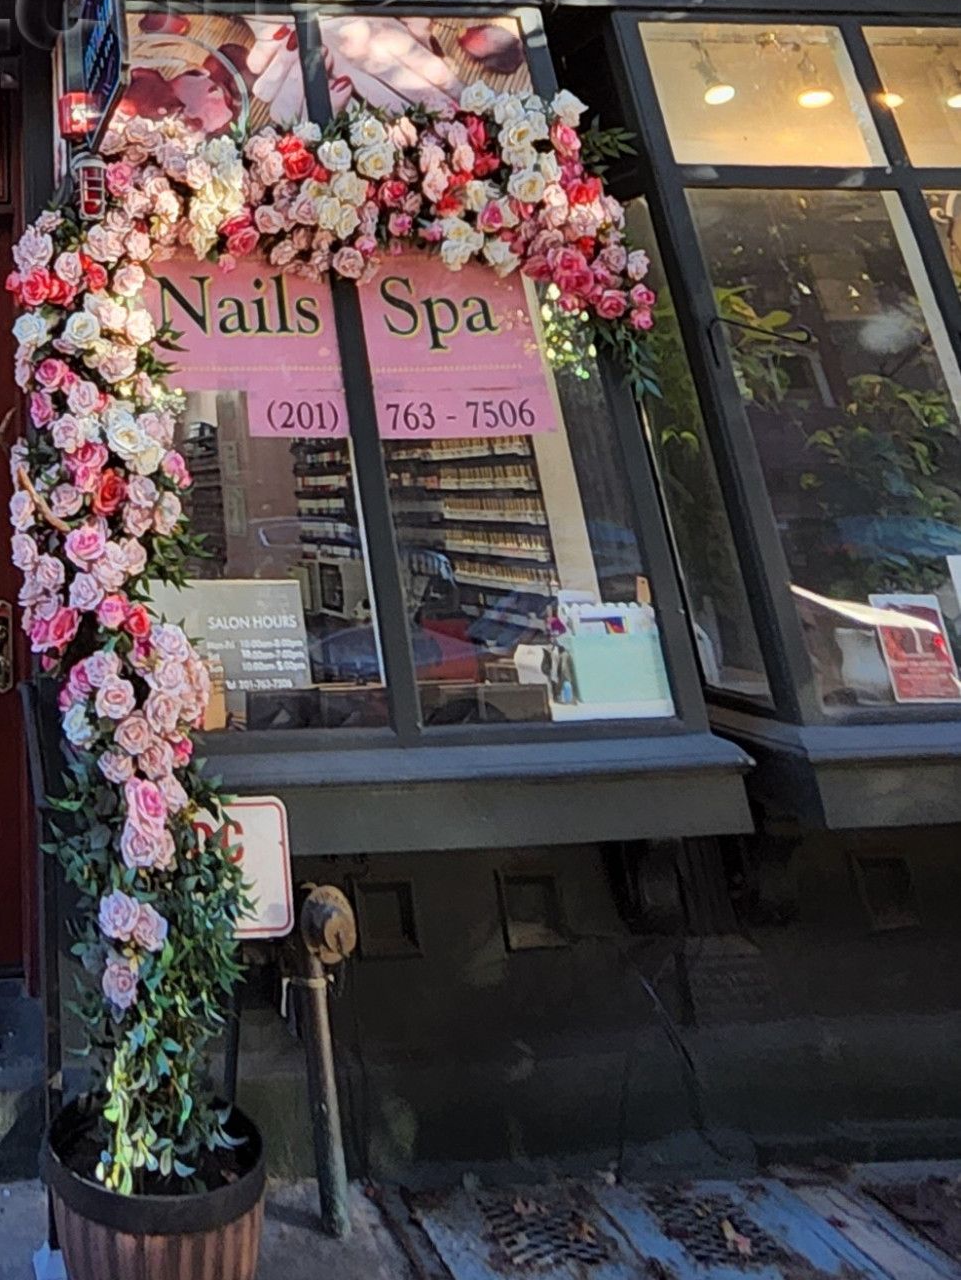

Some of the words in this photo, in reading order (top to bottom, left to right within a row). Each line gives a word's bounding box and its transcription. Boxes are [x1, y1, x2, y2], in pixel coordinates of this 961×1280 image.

[153, 272, 323, 337] Nails
[378, 274, 502, 352] Spa
[266, 399, 339, 431] (201)
[385, 401, 436, 431] 763
[465, 398, 536, 429] 7506
[207, 616, 250, 630] SALON
[252, 614, 298, 628] HOURS
